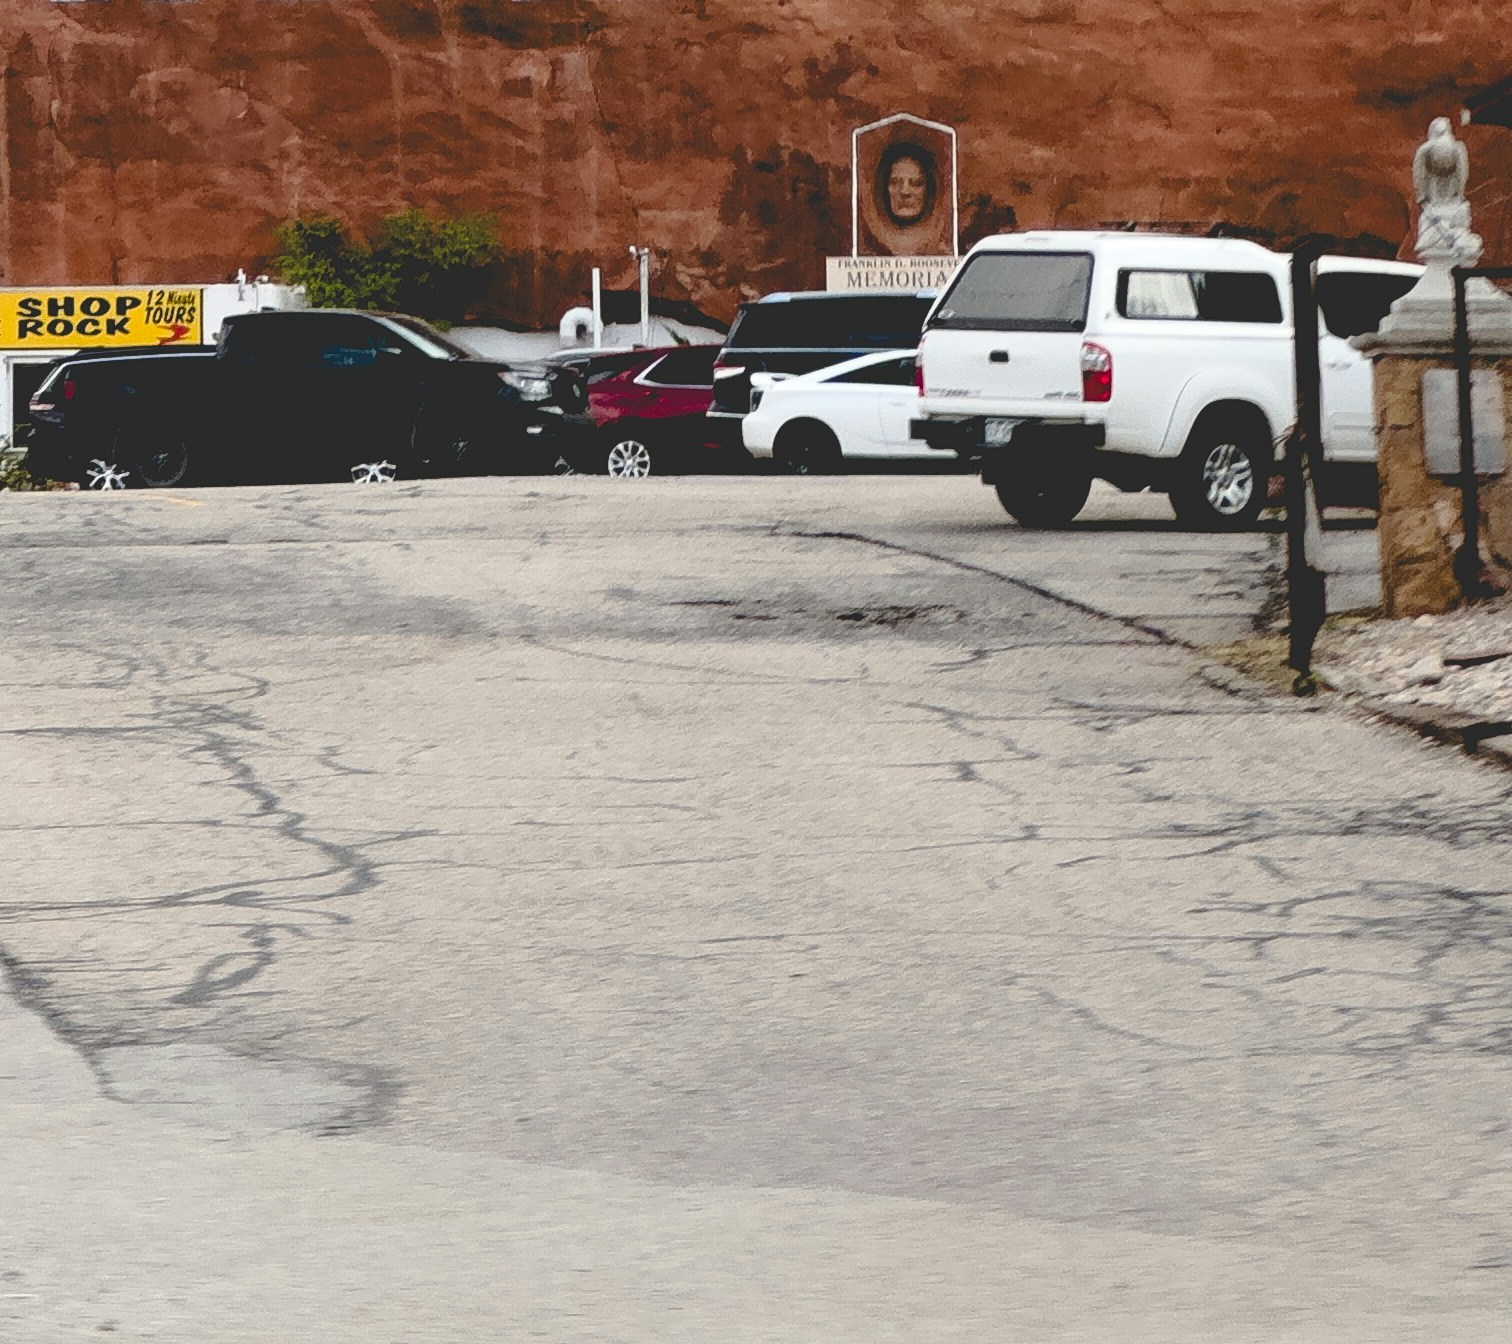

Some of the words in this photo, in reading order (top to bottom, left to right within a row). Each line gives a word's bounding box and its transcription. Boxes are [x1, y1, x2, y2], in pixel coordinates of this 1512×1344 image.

[838, 258, 891, 269] FRANKLIN
[847, 270, 949, 288] MEMORIA
[147, 289, 165, 306] 12
[17, 296, 142, 318] SHOP
[145, 306, 196, 324] TOURS
[18, 317, 131, 339] ROCK
